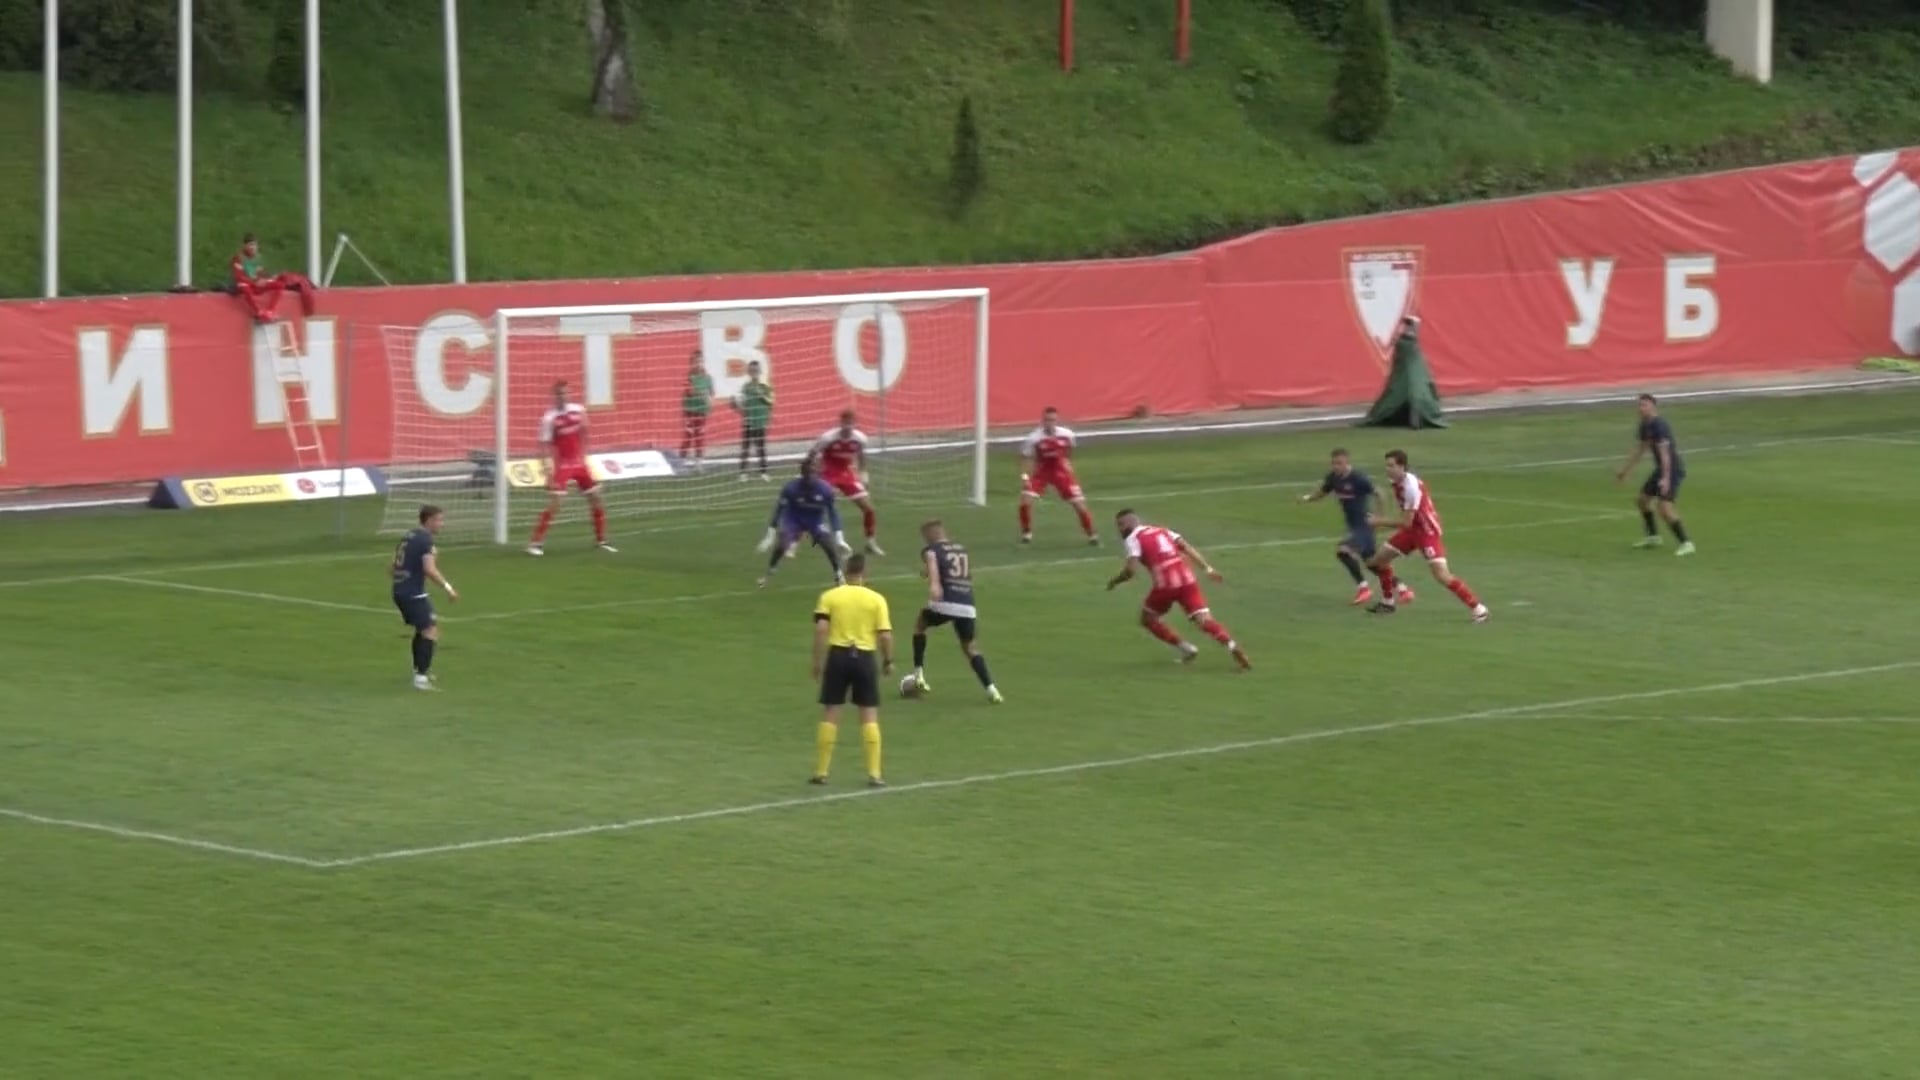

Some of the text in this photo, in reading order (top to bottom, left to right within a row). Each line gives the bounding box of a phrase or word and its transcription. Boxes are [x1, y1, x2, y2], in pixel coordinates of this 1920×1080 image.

[1558, 254, 1720, 348] УБ
[0, 302, 908, 474] ИНСТВО
[947, 551, 969, 577] 37
